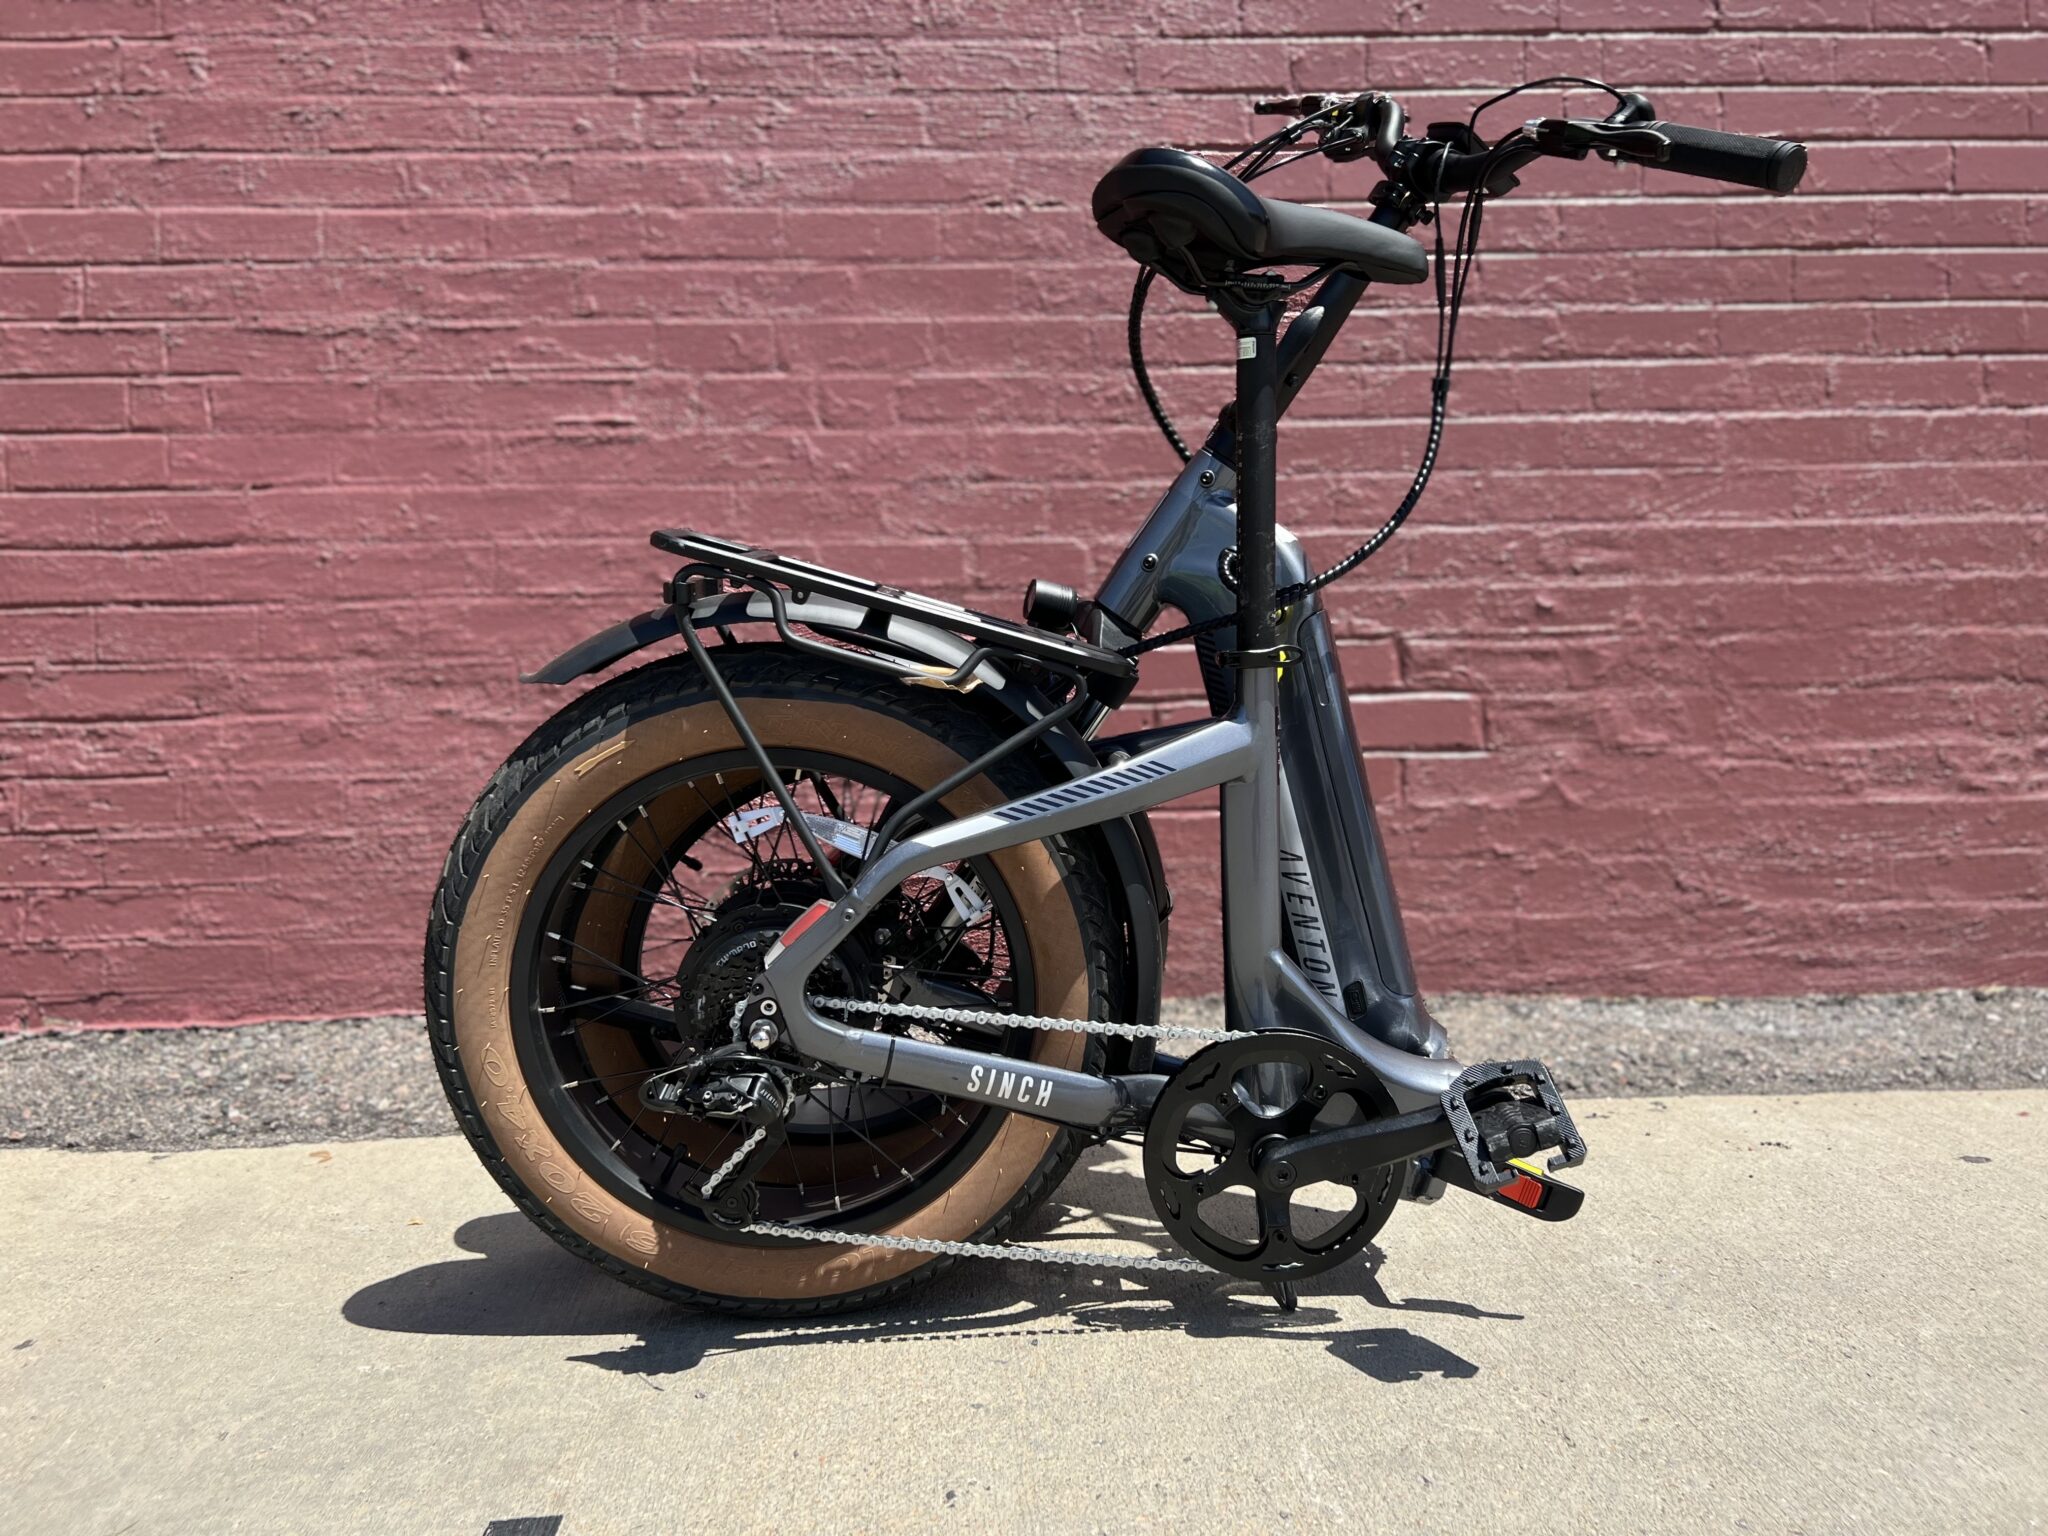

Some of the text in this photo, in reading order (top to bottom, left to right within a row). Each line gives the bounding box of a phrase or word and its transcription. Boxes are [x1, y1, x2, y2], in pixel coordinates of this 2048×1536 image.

[1279, 849, 1338, 999] AVENTON
[490, 933, 503, 967] INFLATE
[967, 1064, 1054, 1108] SINCH
